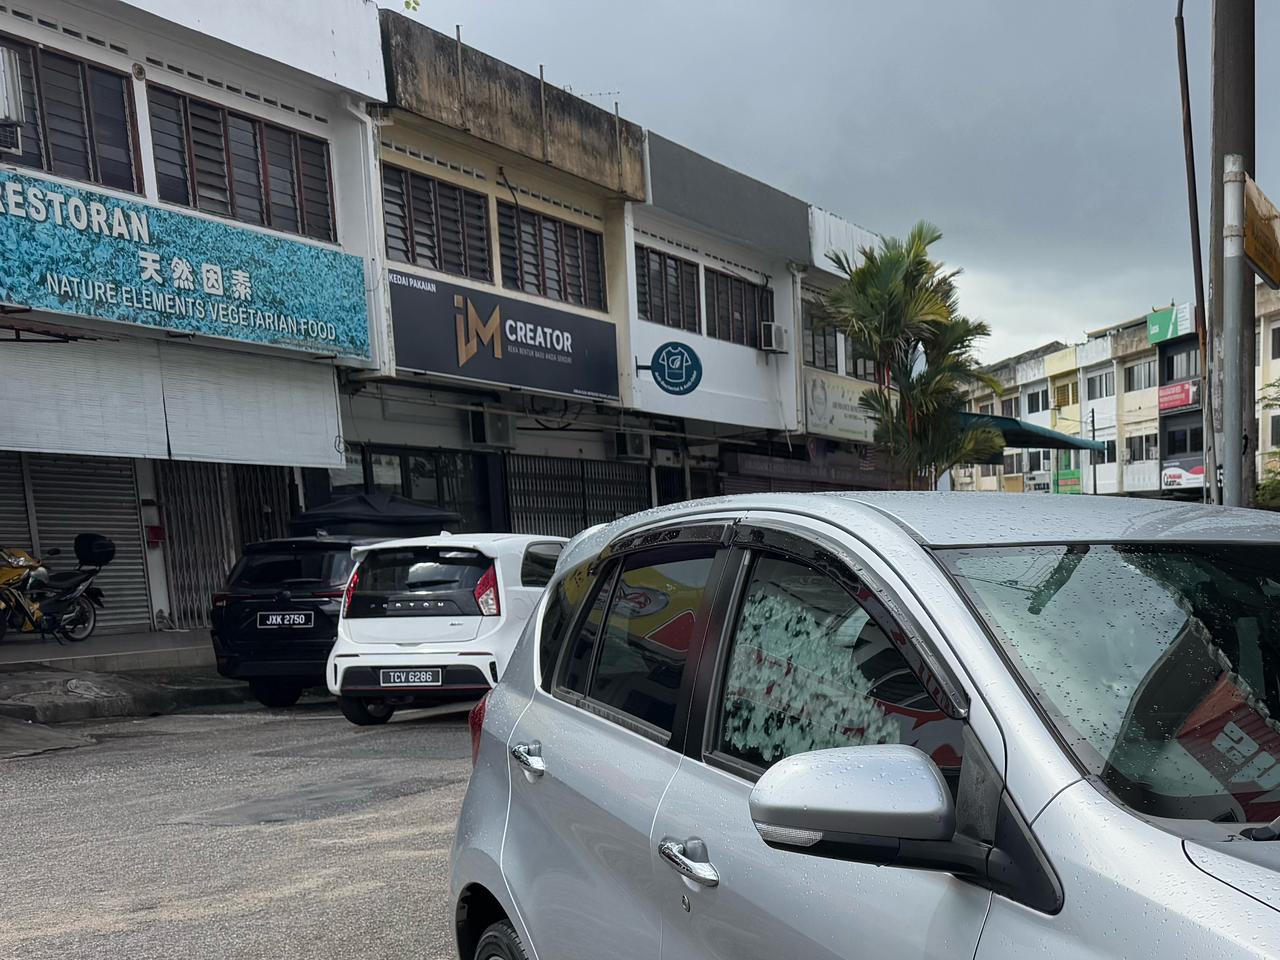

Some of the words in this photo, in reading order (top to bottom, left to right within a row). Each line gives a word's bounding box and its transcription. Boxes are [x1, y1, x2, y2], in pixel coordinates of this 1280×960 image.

[0, 181, 150, 244] ESTORAN
[139, 250, 251, 301] 天然因素
[388, 273, 409, 286] KEDAI
[409, 278, 437, 293] PAKAIAN
[46, 272, 117, 304] NATURE
[122, 287, 206, 318] ELEMENTS
[208, 302, 298, 335] VEGETARIAN
[300, 319, 336, 340] FOOD
[505, 319, 573, 353] CREATOR
[266, 614, 283, 625] JXK
[284, 614, 305, 624] 2750
[389, 672, 406, 682] TCV
[408, 671, 433, 682] 6286
